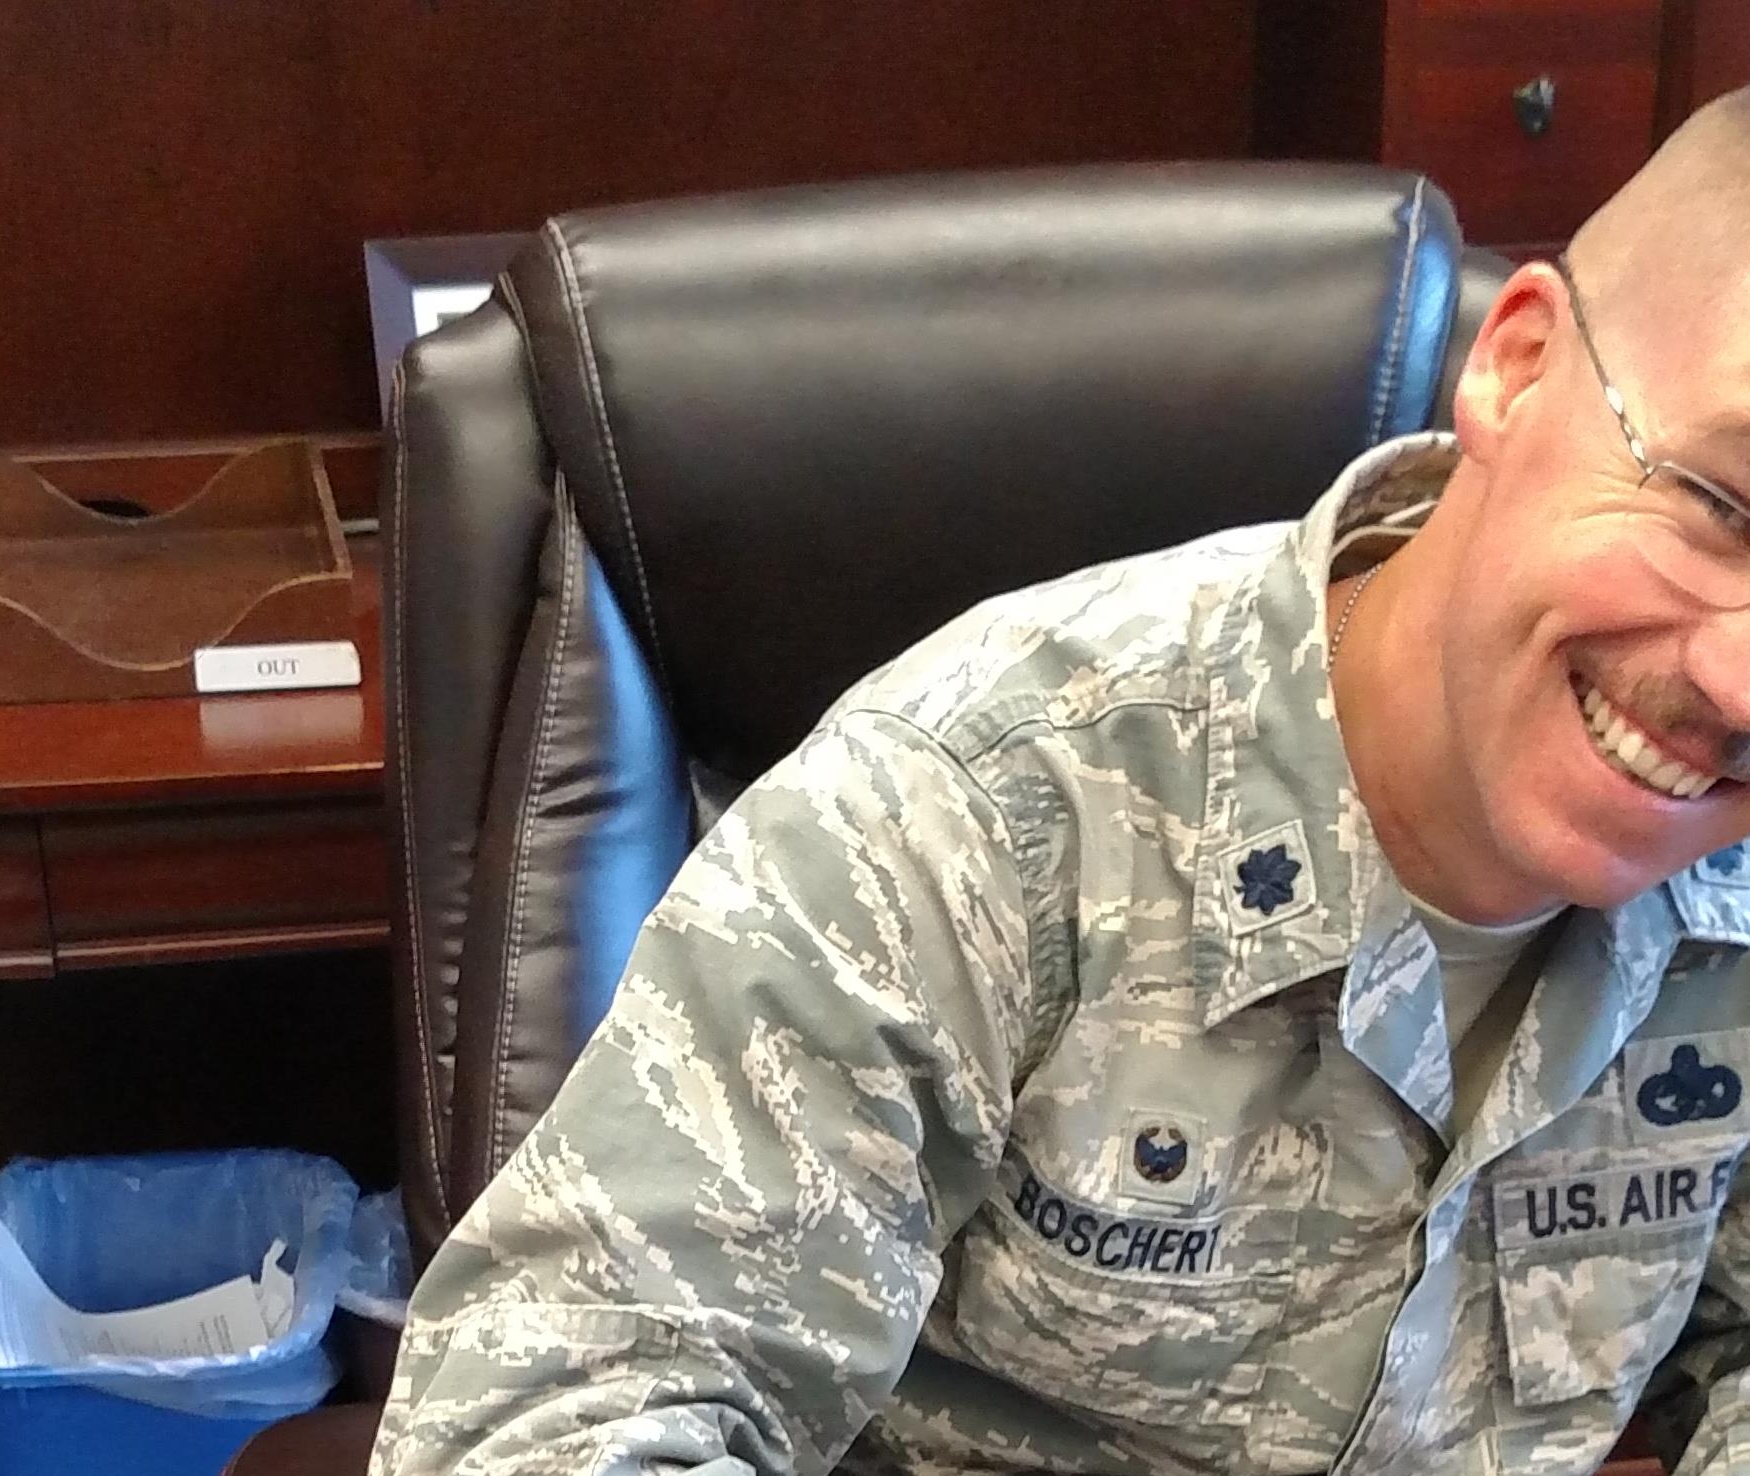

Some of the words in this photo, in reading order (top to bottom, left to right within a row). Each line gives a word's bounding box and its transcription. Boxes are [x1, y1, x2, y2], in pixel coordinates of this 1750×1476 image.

[256, 658, 301, 678] OUT
[1526, 1182, 1607, 1238] U.S.
[1619, 1167, 1698, 1228] AIR
